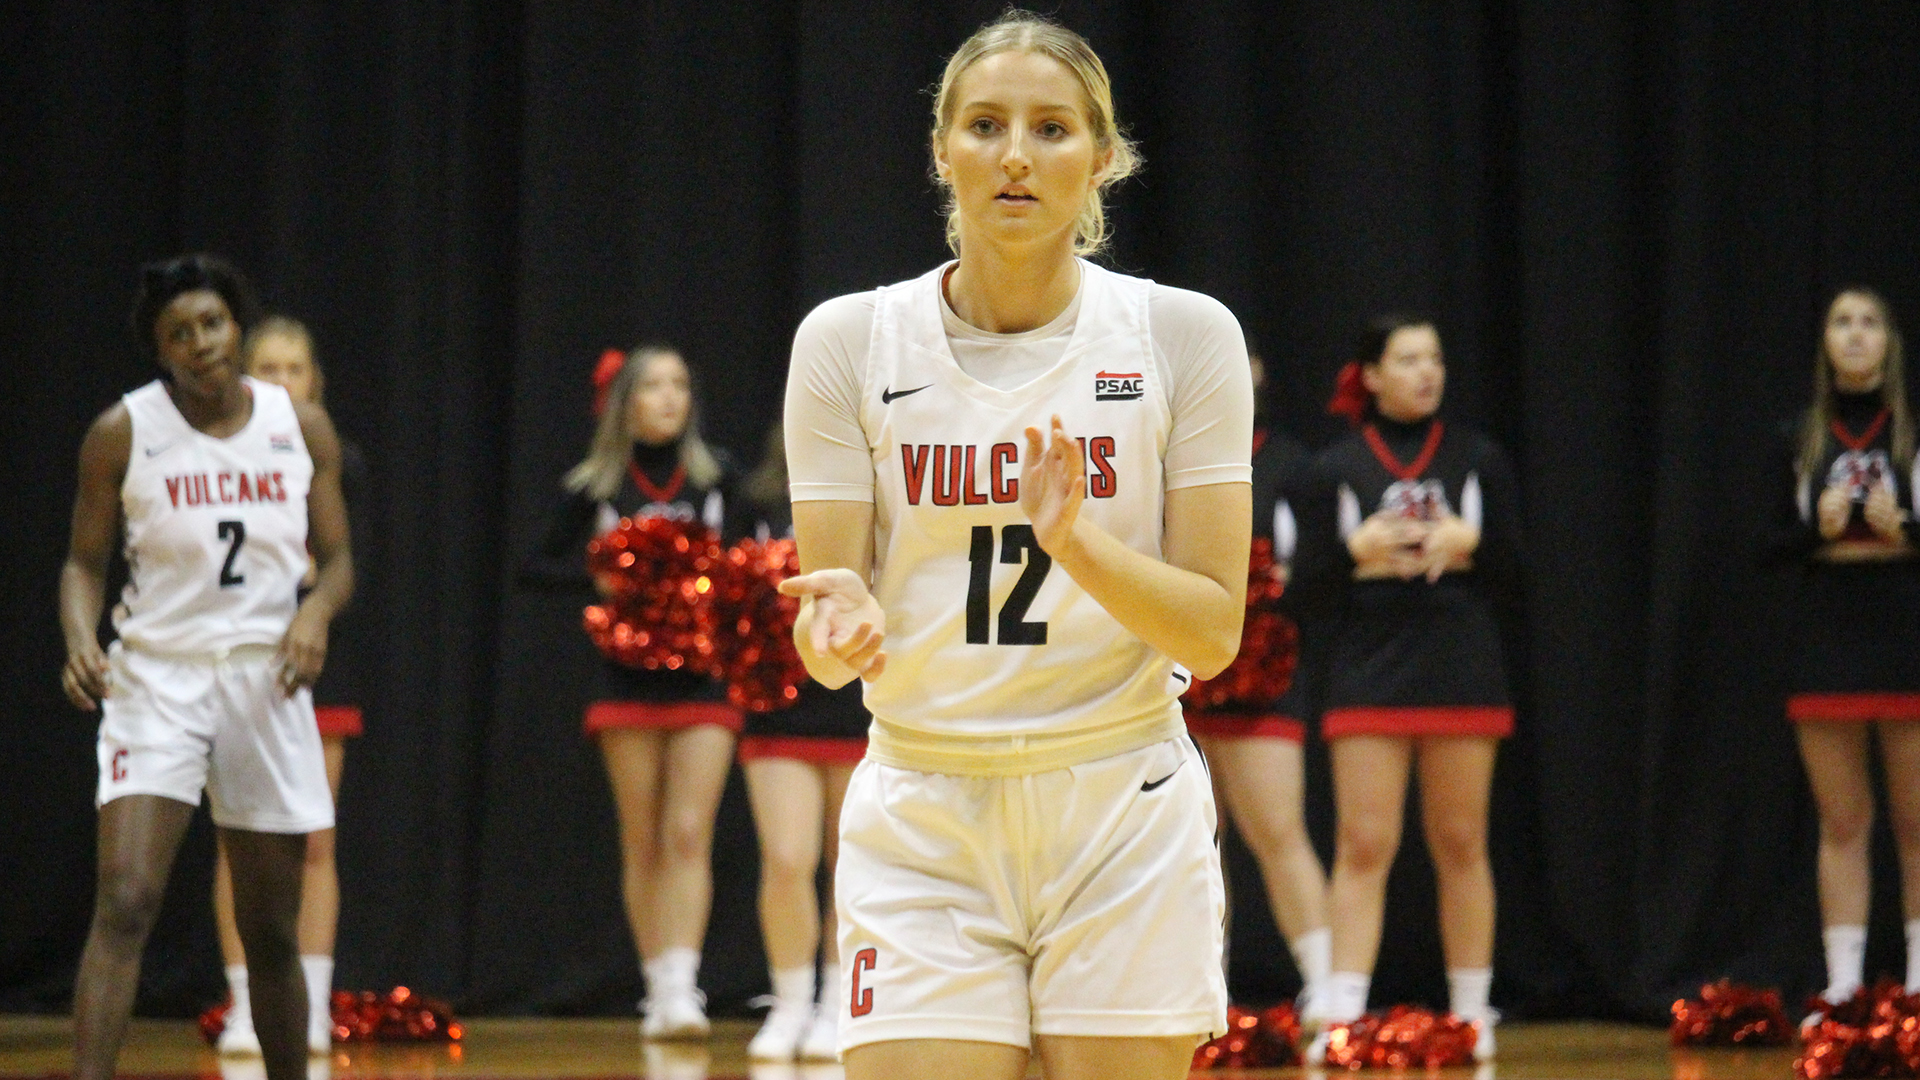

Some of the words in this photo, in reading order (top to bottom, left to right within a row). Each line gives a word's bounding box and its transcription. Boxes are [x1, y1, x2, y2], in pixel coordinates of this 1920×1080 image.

[1095, 379, 1144, 393] PSAC
[165, 470, 287, 508] VULCANS
[901, 436, 1116, 506] VULCS
[218, 520, 246, 587] 2
[966, 524, 1052, 645] 12
[112, 749, 128, 783] C
[851, 948, 877, 1018] C
